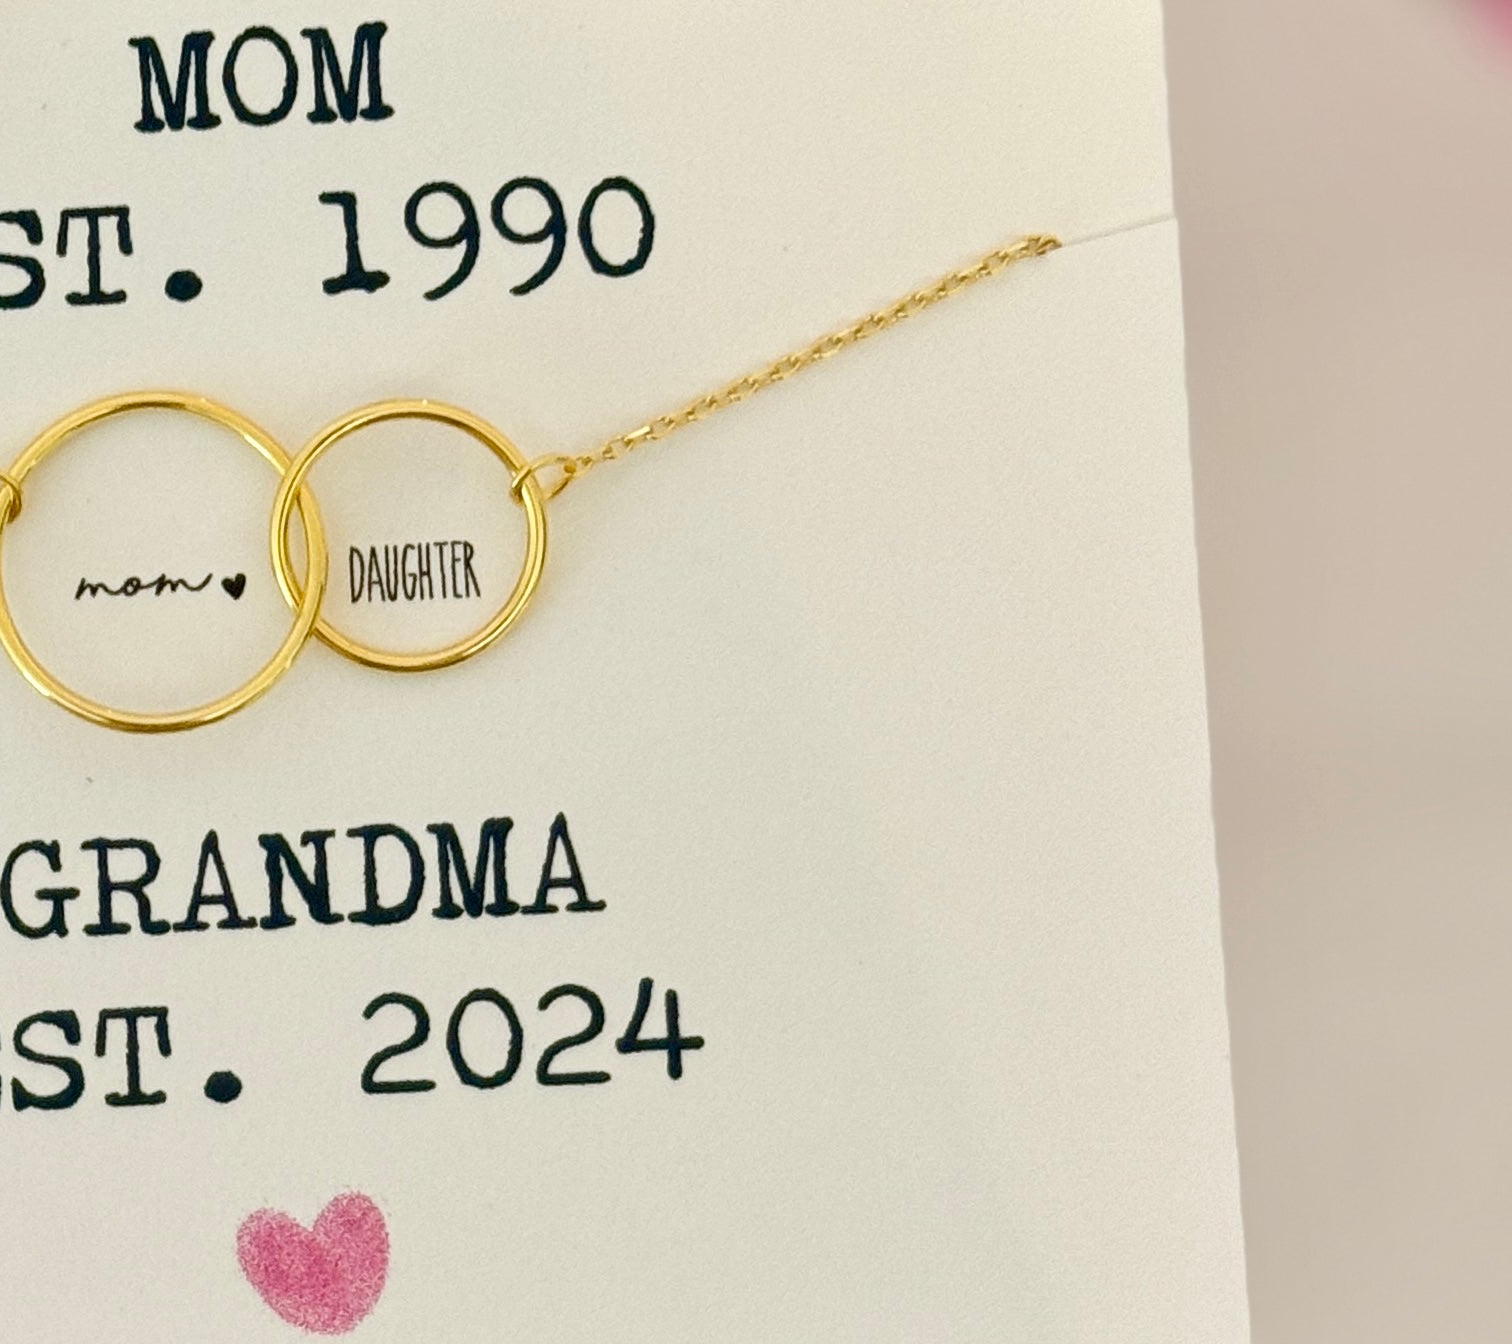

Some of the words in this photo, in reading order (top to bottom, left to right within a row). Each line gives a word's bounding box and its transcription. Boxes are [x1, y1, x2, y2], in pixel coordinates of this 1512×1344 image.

[127, 20, 396, 135] MOM
[317, 175, 657, 302] 1990
[73, 570, 214, 602] mom
[347, 540, 482, 604] DAUGHTER
[360, 976, 706, 1096] 2024
